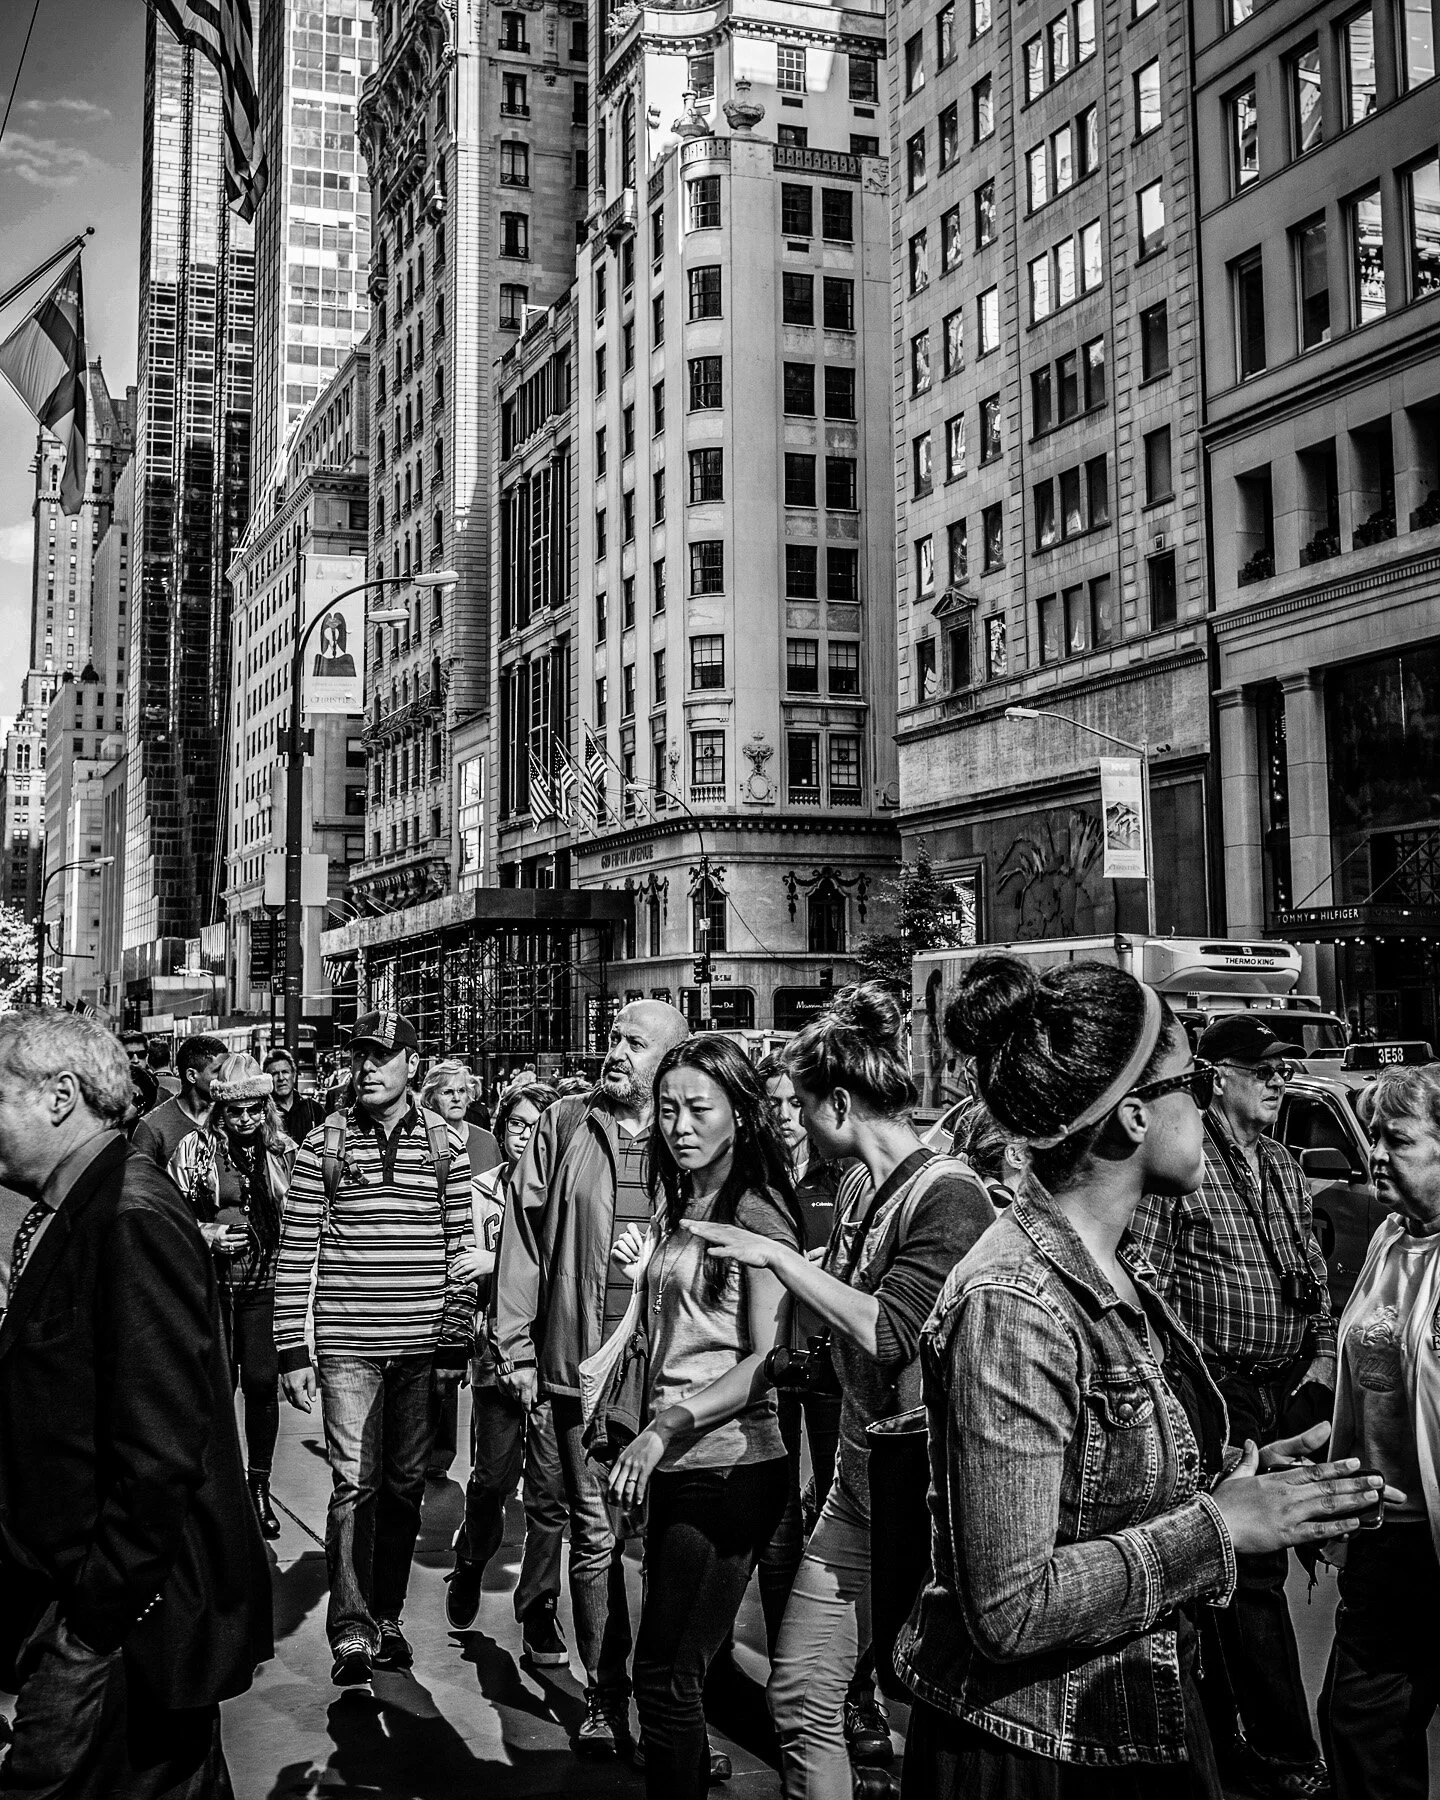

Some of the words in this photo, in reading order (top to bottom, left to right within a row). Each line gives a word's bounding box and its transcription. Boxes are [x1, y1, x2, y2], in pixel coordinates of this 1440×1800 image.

[1276, 912, 1309, 924] TOMMY
[1320, 908, 1359, 921] HILFIGER
[1225, 957, 1256, 965] THERMO
[1257, 958, 1275, 966] KING
[1378, 1046, 1404, 1064] 3E58
